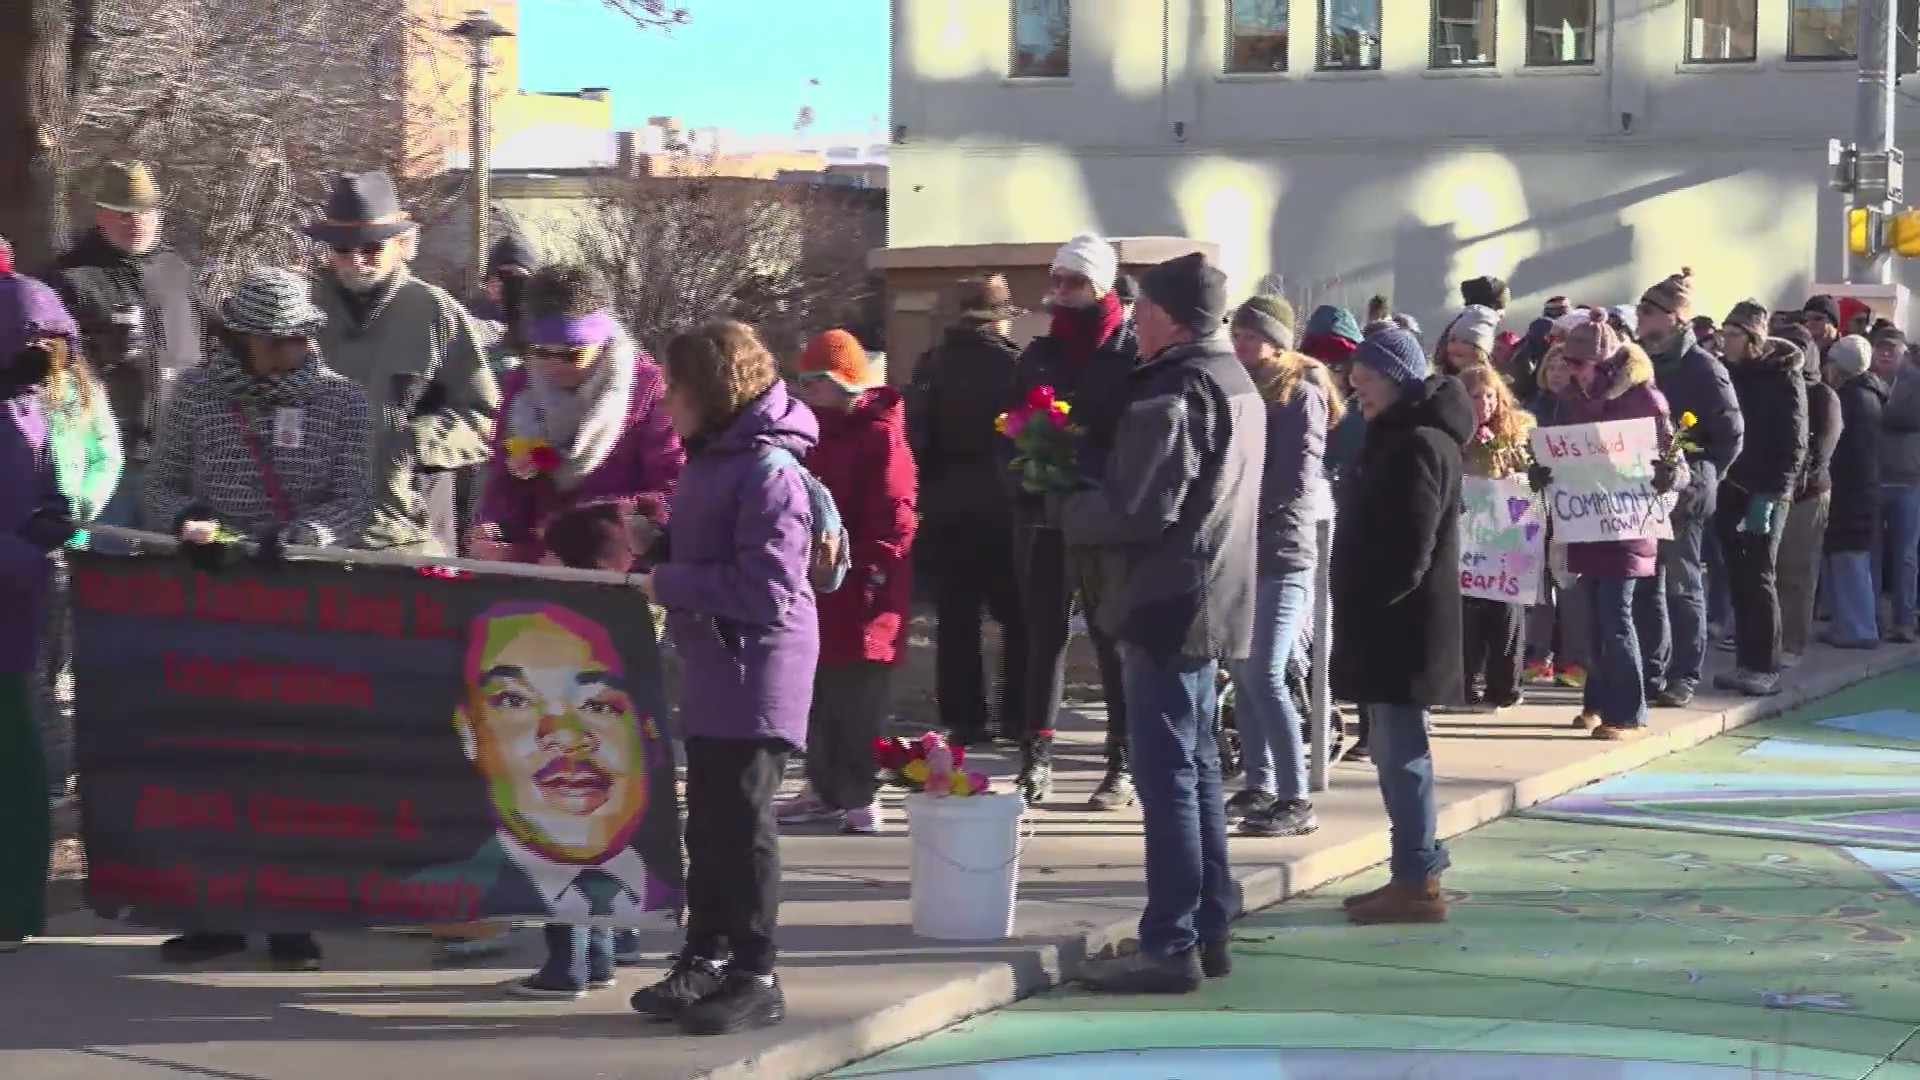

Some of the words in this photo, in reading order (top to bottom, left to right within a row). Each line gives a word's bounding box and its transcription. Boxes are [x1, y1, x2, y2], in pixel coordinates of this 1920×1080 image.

[1546, 433, 1581, 458] let's
[1585, 431, 1625, 455] bud
[1459, 570, 1519, 597] earts
